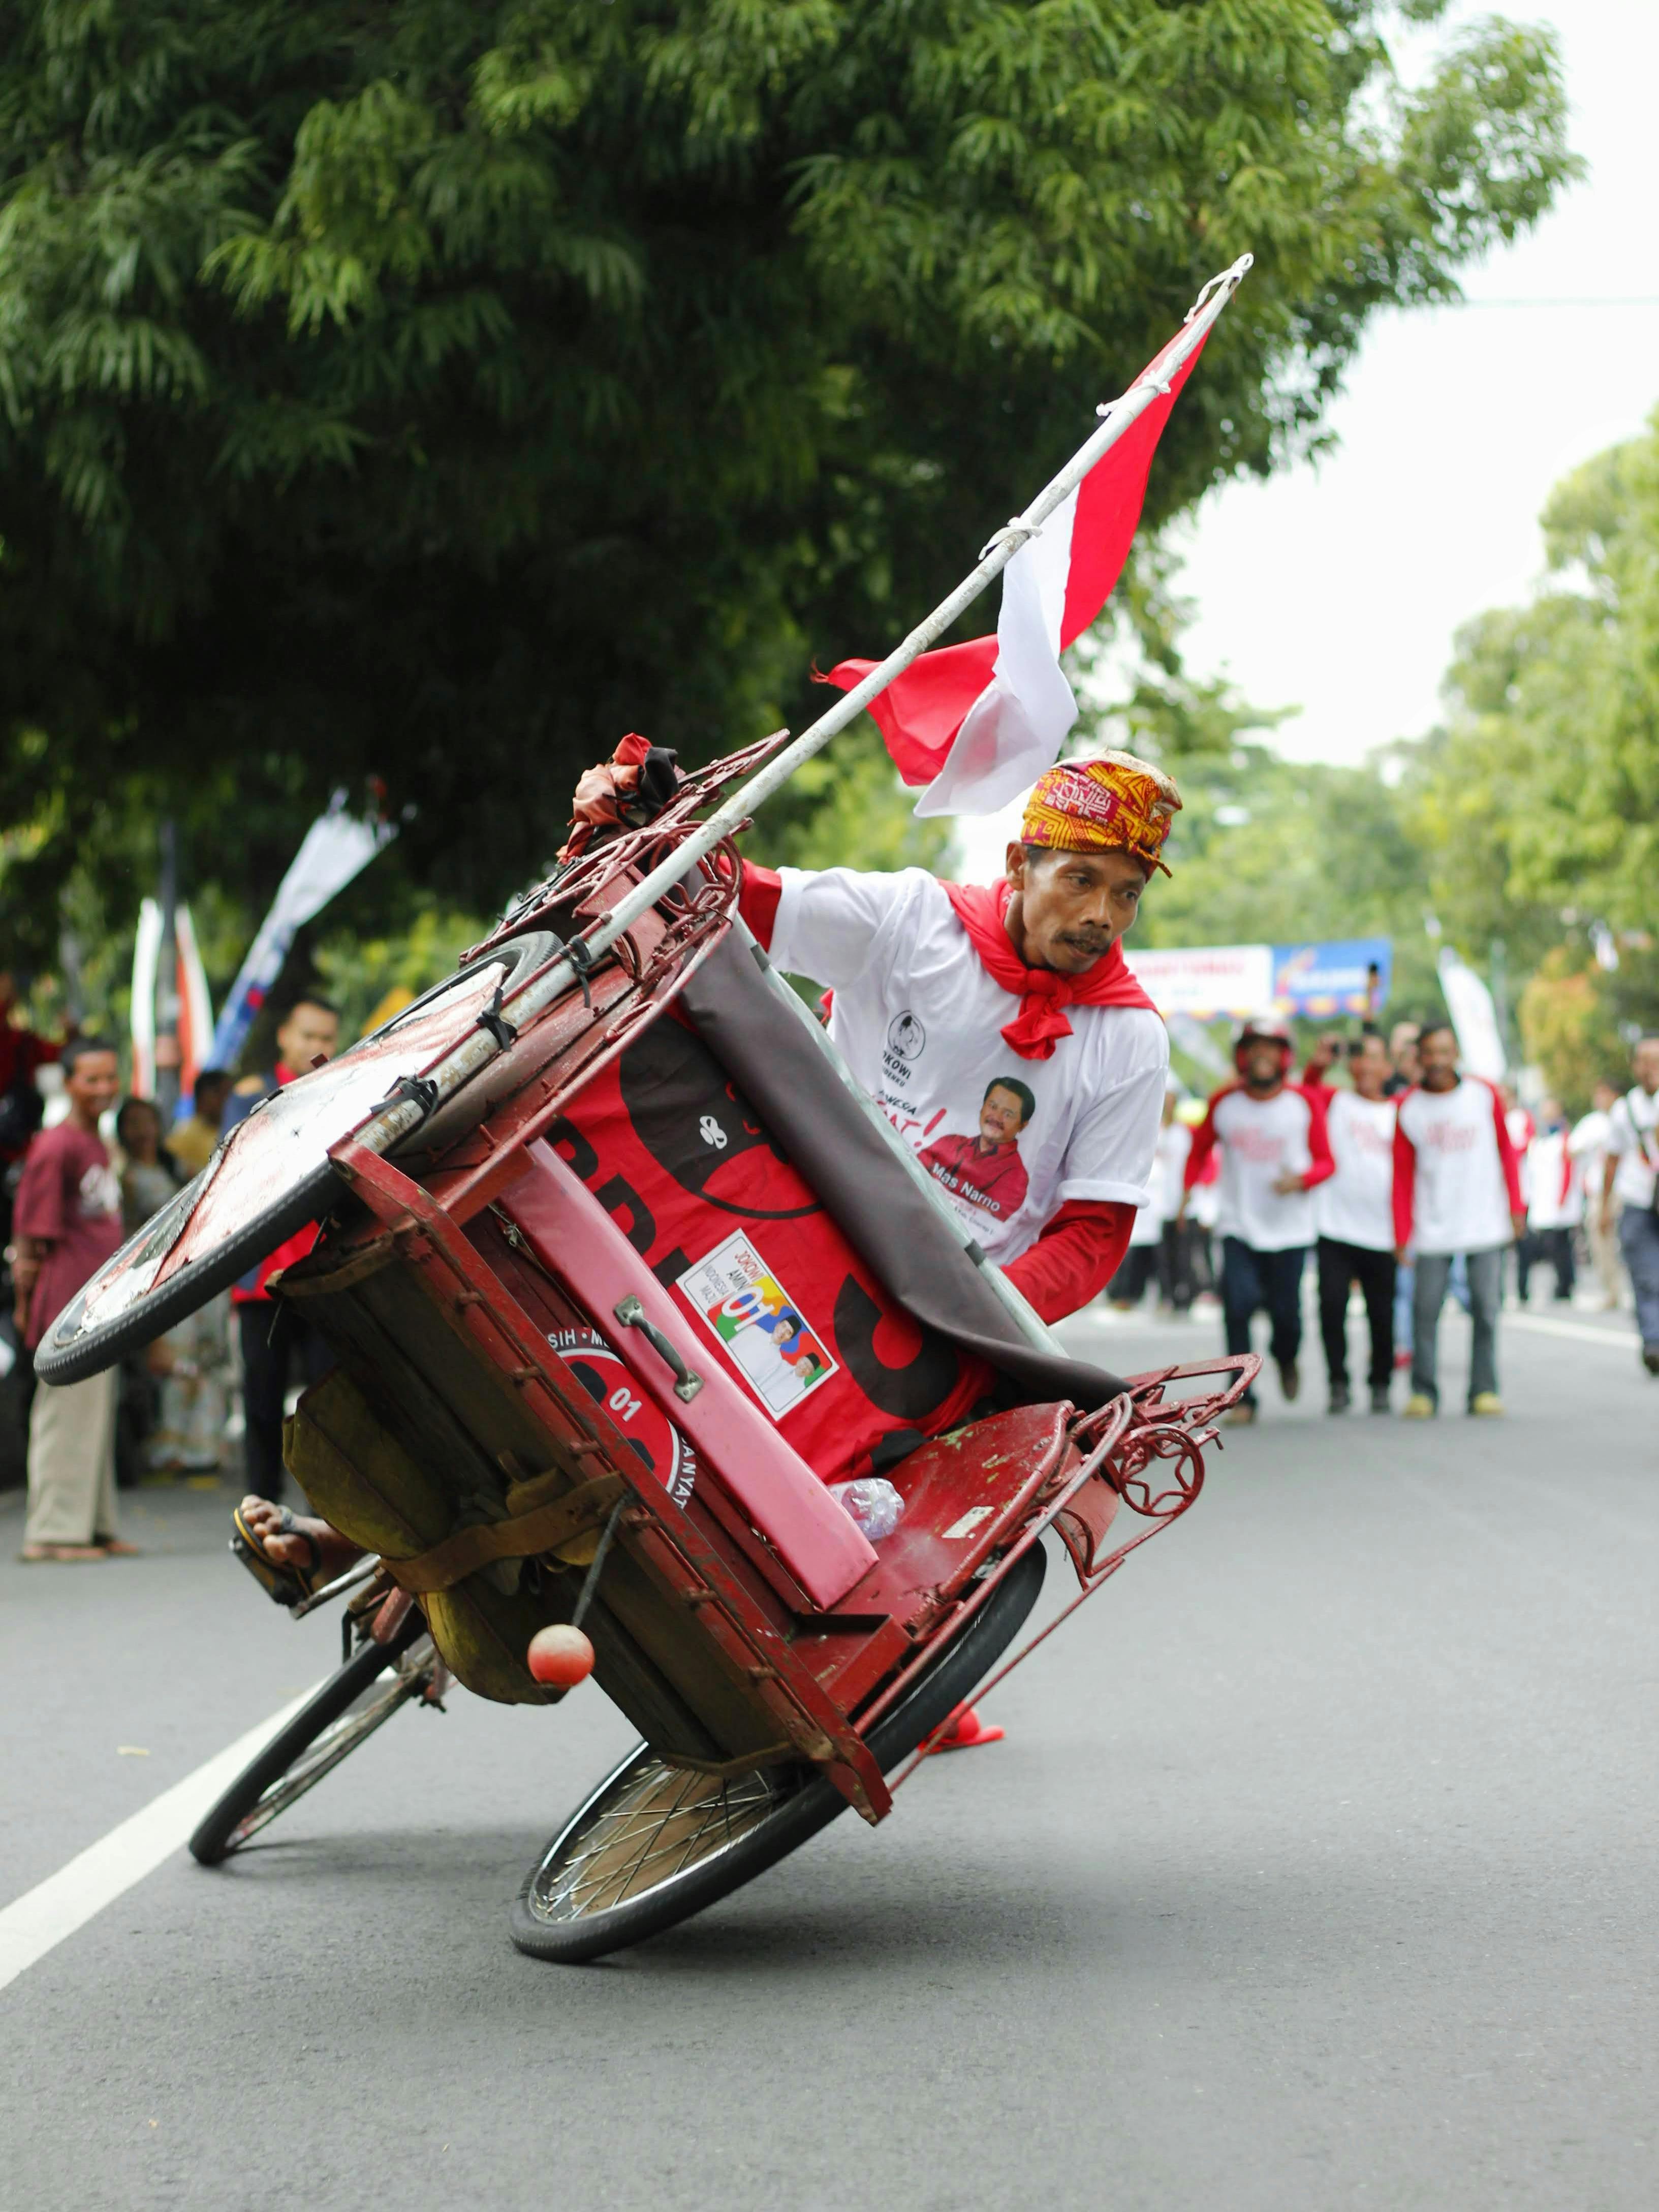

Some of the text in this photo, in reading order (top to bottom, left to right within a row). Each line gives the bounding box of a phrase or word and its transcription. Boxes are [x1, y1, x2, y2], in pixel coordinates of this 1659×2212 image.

[883, 1050, 911, 1079] KOWI
[932, 1162, 958, 1188] Mas
[960, 1181, 1000, 1211] Narno
[703, 1265, 729, 1295] INDONESIA
[726, 1269, 749, 1291] AMIN
[735, 1250, 765, 1282] JOKOWI
[722, 1286, 774, 1332] 01
[548, 1329, 576, 1348] SIH
[610, 1388, 642, 1422] 01
[672, 1462, 696, 1509] NYAT
